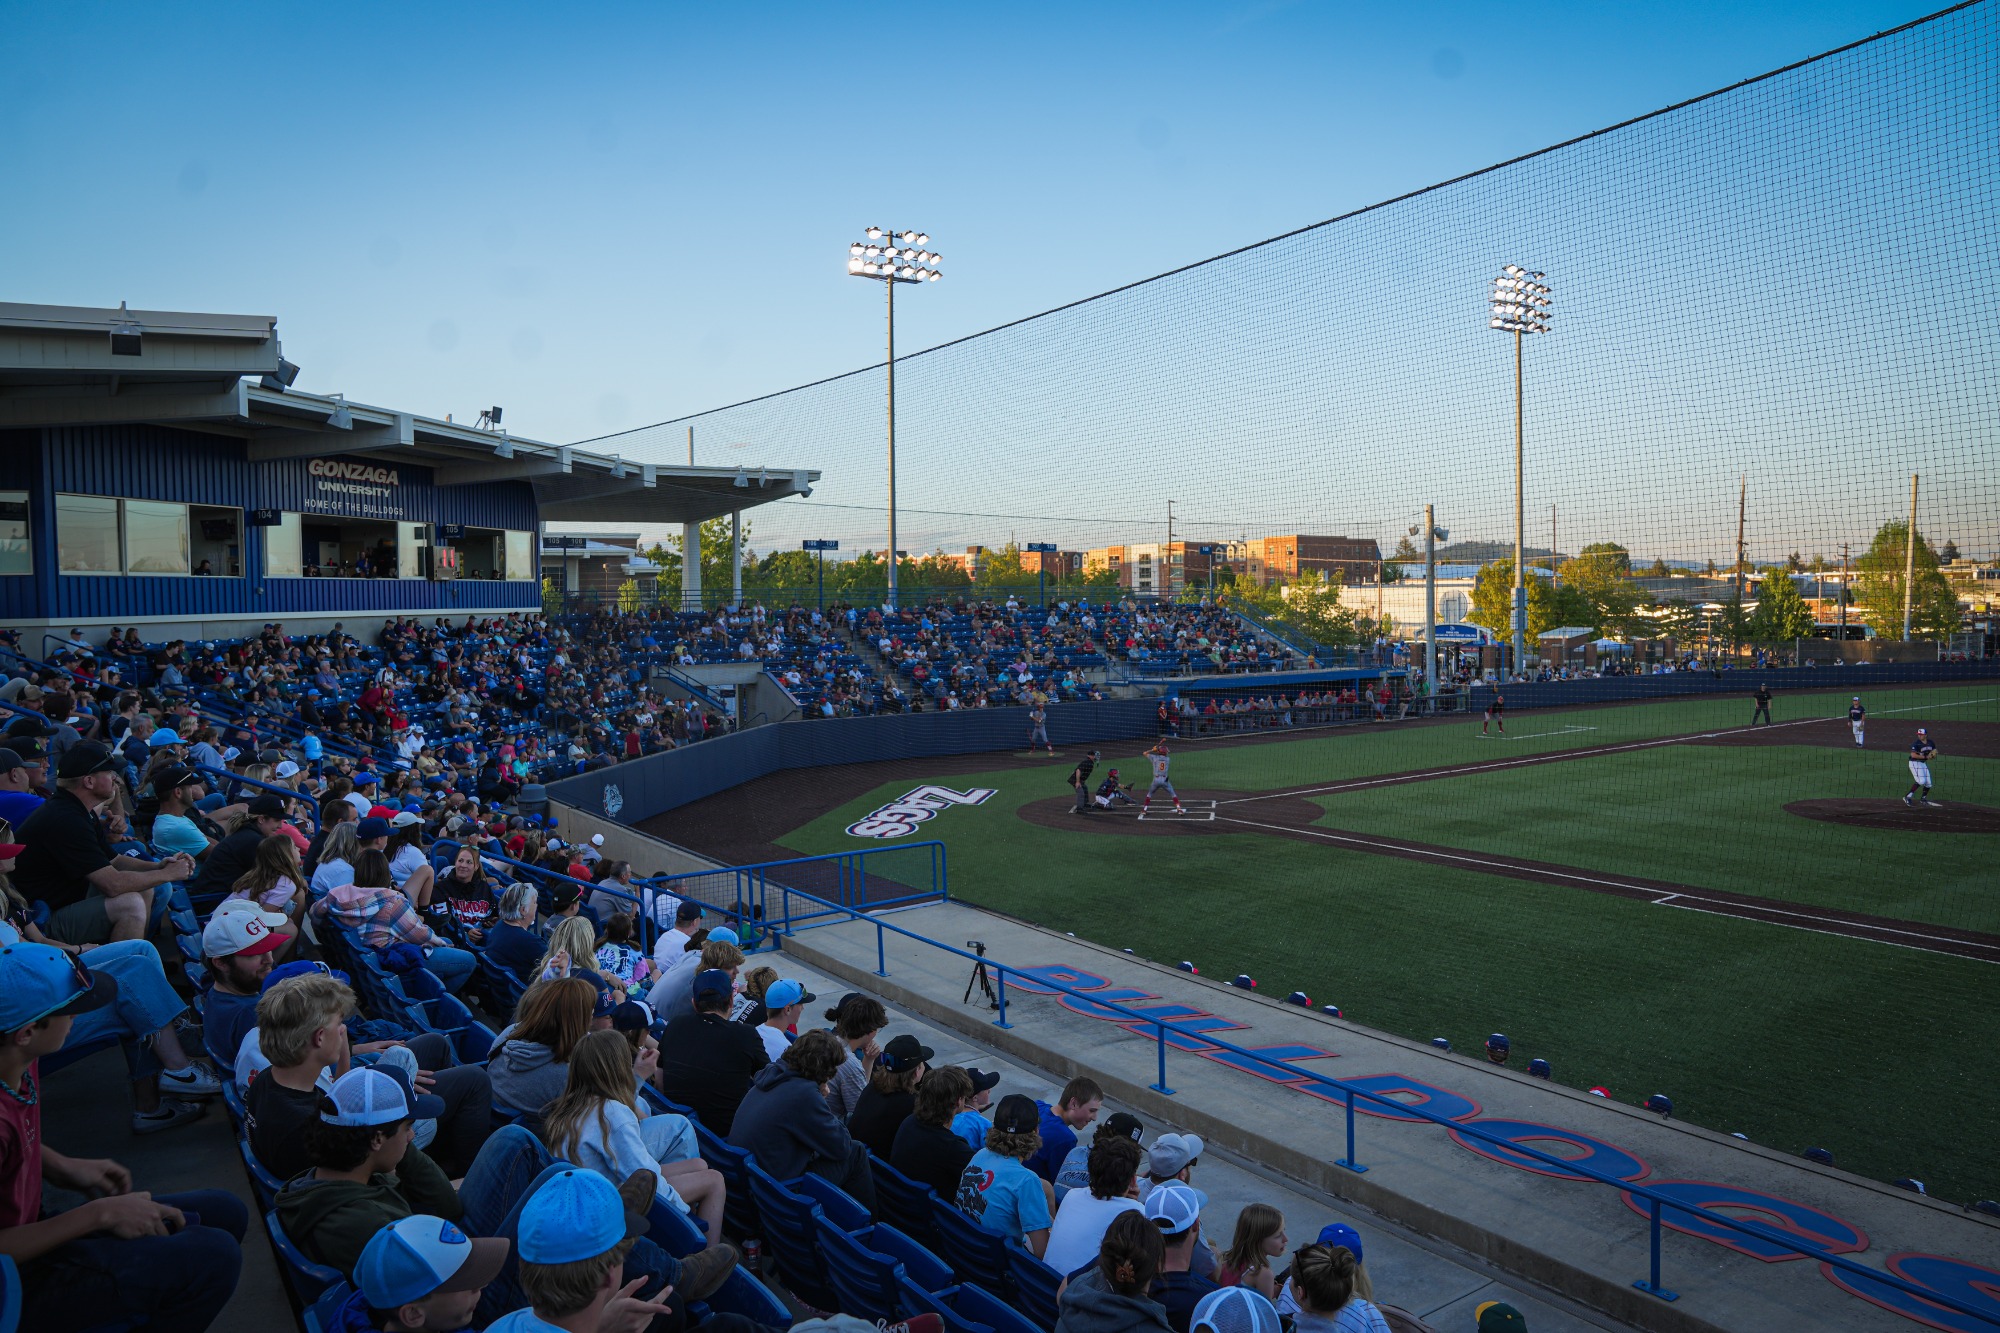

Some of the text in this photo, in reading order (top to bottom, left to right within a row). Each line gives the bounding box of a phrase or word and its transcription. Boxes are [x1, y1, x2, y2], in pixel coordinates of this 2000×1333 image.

[307, 458, 399, 486] GONZAGA
[318, 481, 391, 498] UNIVERSITY
[257, 510, 272, 519] 104
[304, 498, 404, 516] HOME OF THE BULLDOGS
[445, 526, 459, 534] 105
[845, 784, 999, 839] ZAGS
